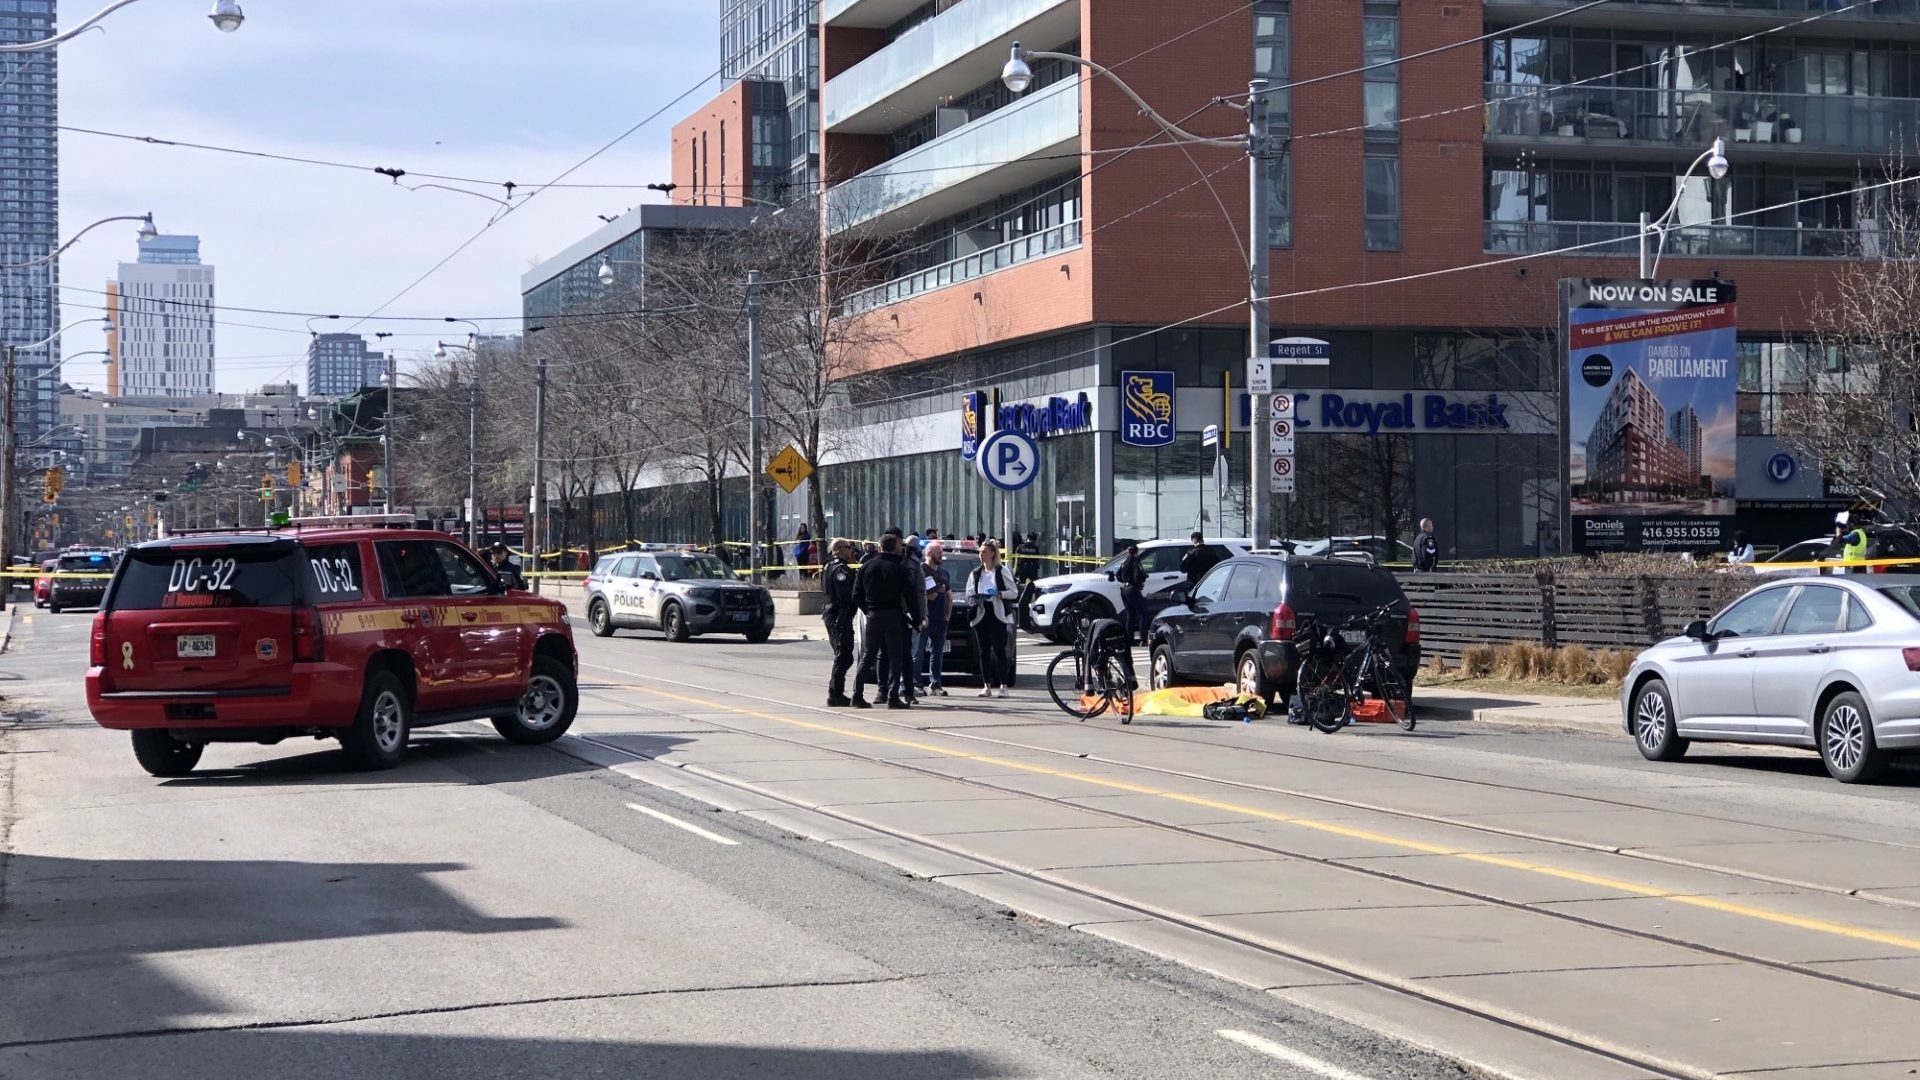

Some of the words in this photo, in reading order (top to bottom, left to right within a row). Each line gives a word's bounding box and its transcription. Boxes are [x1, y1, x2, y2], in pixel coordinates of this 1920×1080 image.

[1590, 286, 1636, 301] NOW
[1639, 286, 1665, 302] ON
[1672, 287, 1717, 302] SALE
[1596, 325, 1613, 333] BEST
[1615, 322, 1636, 331] VALUE
[1646, 318, 1660, 326] THE
[1662, 312, 1705, 324] DOWNTOWN
[1706, 308, 1725, 316] CORE
[1614, 330, 1630, 340] WE
[1632, 327, 1652, 337] CAN
[1655, 322, 1688, 335] PROVE
[1690, 320, 1702, 330] IT!
[1278, 345, 1310, 356] Regent
[1315, 345, 1322, 354] St
[1648, 346, 1678, 357] DANIELS
[1680, 346, 1691, 357] ON
[1649, 359, 1728, 378] PARLIAMENT
[1053, 392, 1091, 430] Bank
[1322, 393, 1415, 437] Royal
[1424, 394, 1510, 429] Bank
[1129, 424, 1169, 438] RBC
[963, 440, 976, 454] RBC
[998, 442, 1020, 476] P
[1585, 520, 1624, 529] Daniels
[1642, 527, 1720, 538] 416.955.0559
[168, 558, 236, 591] DC-32
[311, 558, 358, 593] DC-32
[613, 593, 645, 608] POLICE
